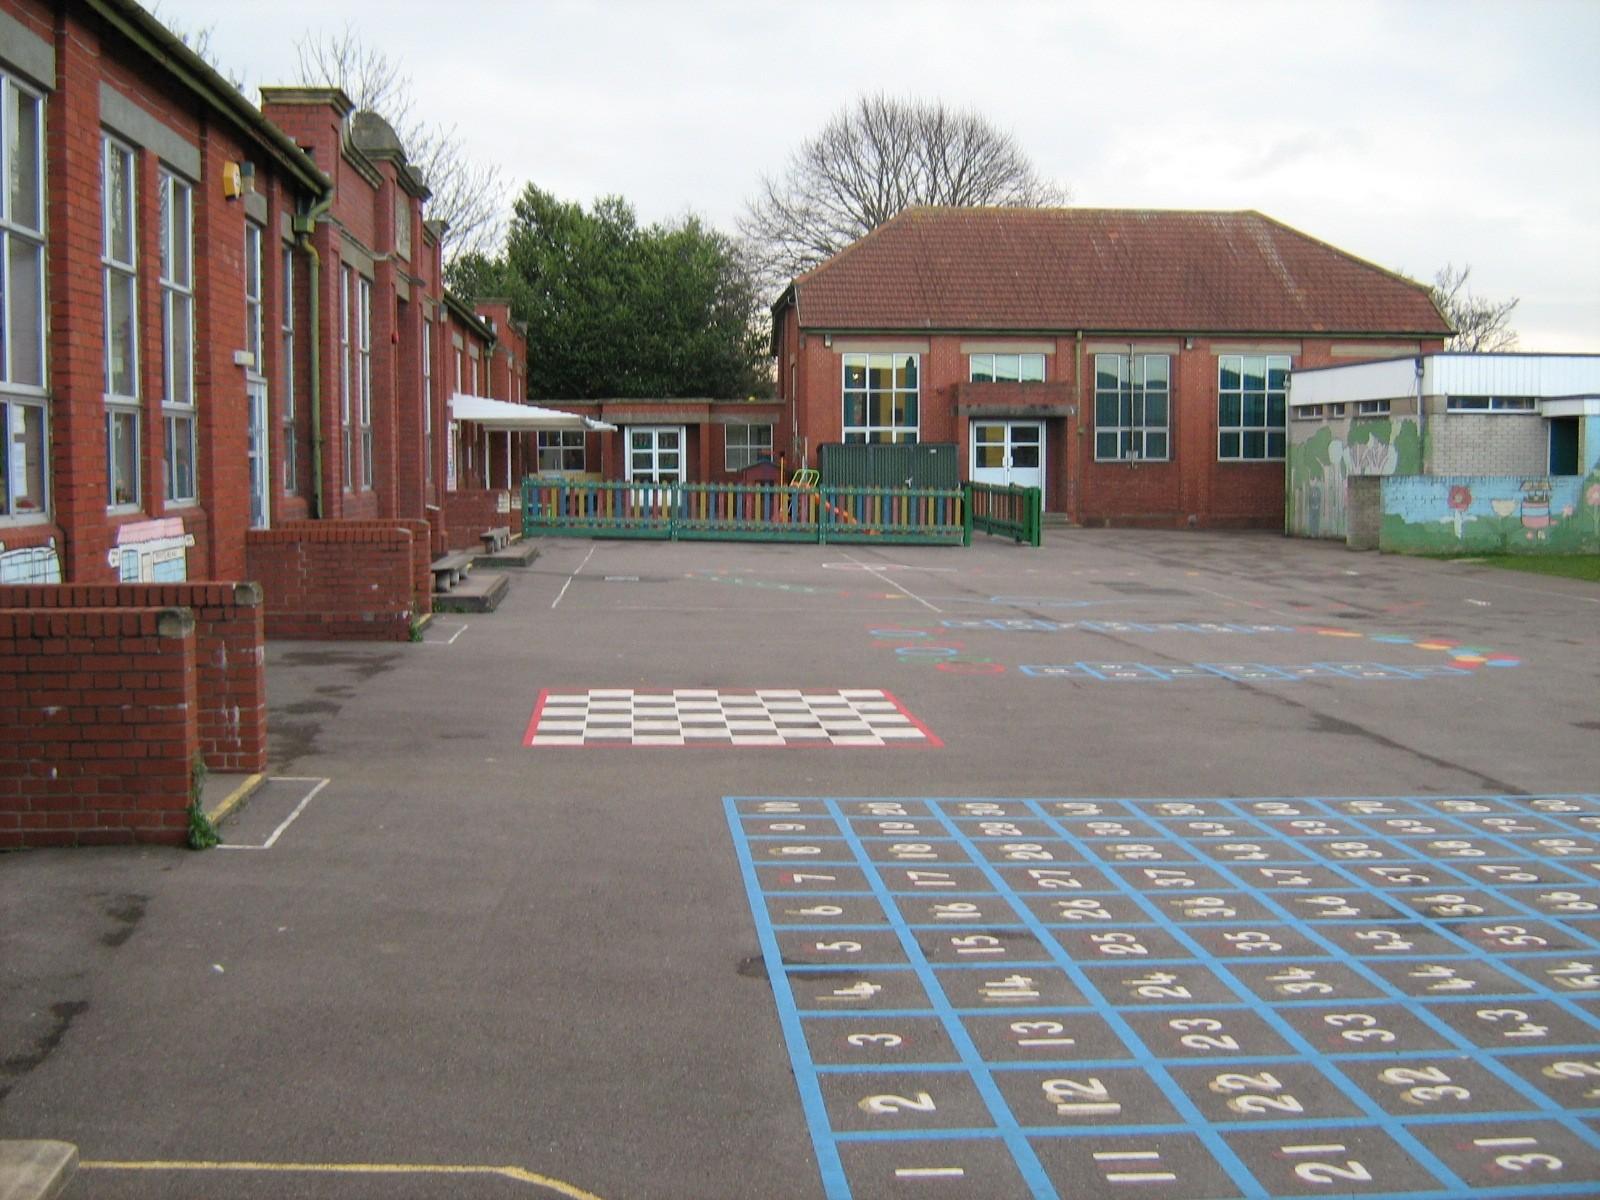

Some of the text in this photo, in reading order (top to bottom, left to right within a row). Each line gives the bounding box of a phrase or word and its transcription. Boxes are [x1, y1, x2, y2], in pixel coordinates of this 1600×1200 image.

[877, 821, 921, 835] 19
[978, 822, 1024, 836] 29
[1085, 821, 1132, 836] 39
[1187, 822, 1236, 836] 49
[1289, 820, 1341, 835] 59
[1385, 819, 1437, 834] 69
[1481, 818, 1537, 833] 79
[780, 846, 823, 855] 8
[892, 843, 939, 859] 18
[1002, 843, 1055, 860] 28
[1115, 844, 1164, 859] 38
[1222, 843, 1270, 860] 48
[1330, 841, 1384, 858] 58
[1433, 840, 1487, 857] 68
[1537, 838, 1594, 855] 78
[792, 873, 837, 884] 7
[905, 871, 958, 886] 17
[1027, 869, 1084, 889] 27
[1142, 869, 1197, 887] 37
[1259, 868, 1313, 885] 47
[1367, 867, 1431, 883] 57
[1478, 865, 1539, 882] 67
[1057, 899, 1113, 920] 26
[1183, 896, 1238, 917] 36
[1304, 896, 1362, 916] 46
[1423, 894, 1485, 914] 56
[1539, 891, 1599, 911] 66
[798, 905, 844, 916] 6
[933, 902, 983, 919] 16
[950, 935, 1007, 954] 15
[1089, 932, 1150, 955] 25
[1222, 931, 1284, 952] 35
[1354, 930, 1415, 951] 45
[1481, 925, 1549, 946] 55
[814, 941, 863, 953] 5
[1130, 972, 1194, 999] 24
[1271, 968, 1335, 994] 34
[1411, 966, 1477, 990] 44
[829, 981, 883, 999] 4
[984, 974, 1041, 1002] 14
[1323, 1013, 1397, 1042] 33
[1475, 1009, 1550, 1038] 43
[846, 1033, 903, 1047] 3
[1009, 1021, 1077, 1046] 13
[1168, 1018, 1241, 1050] 23
[1383, 1066, 1472, 1101] 32
[1552, 1061, 1600, 1096] 2
[1040, 1078, 1123, 1115] 12
[1214, 1072, 1305, 1114] 22
[864, 1093, 938, 1114] 2
[1472, 1137, 1564, 1171] 31
[893, 1168, 966, 1178] 1
[1091, 1151, 1178, 1183] 11
[1280, 1144, 1374, 1184] 21
